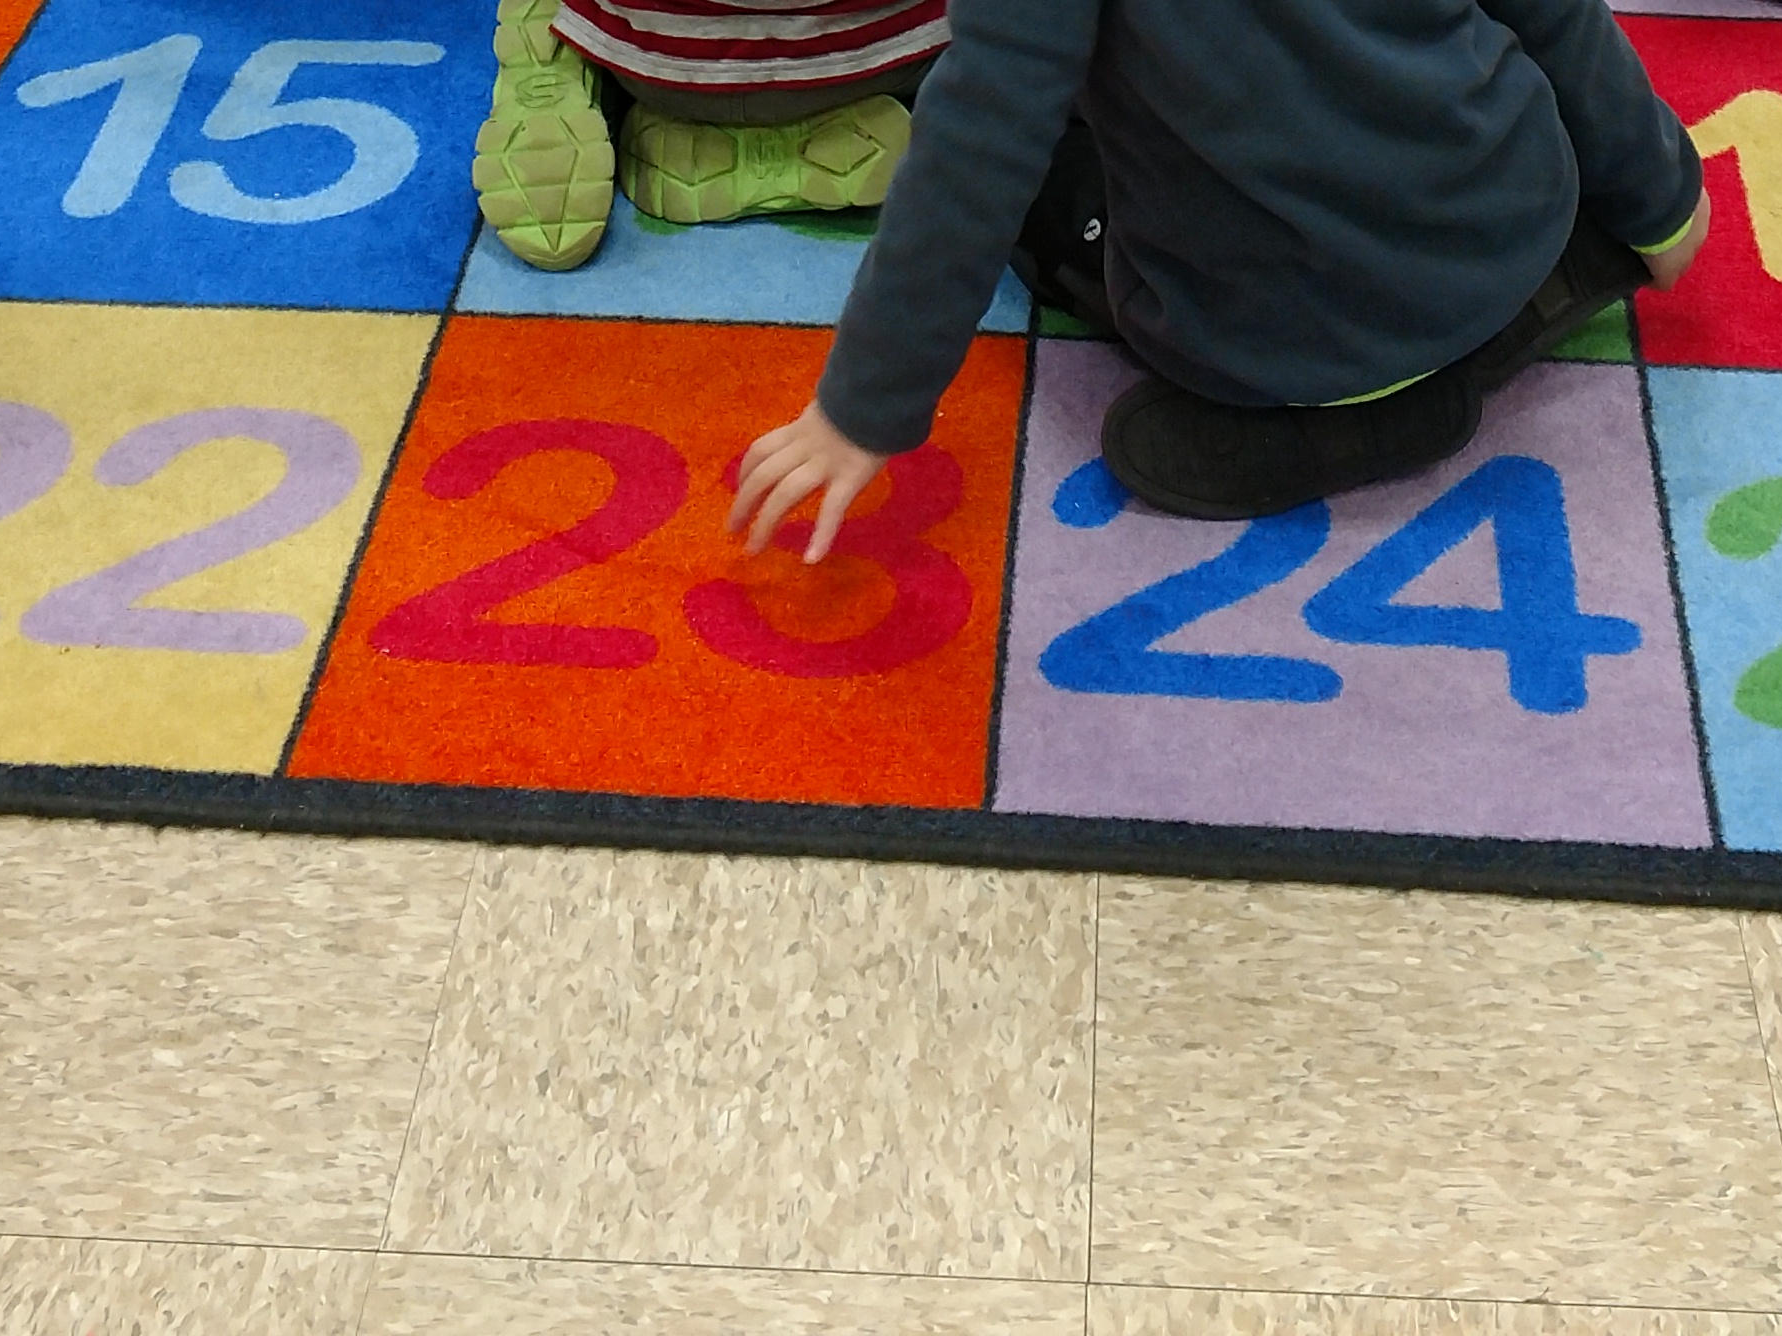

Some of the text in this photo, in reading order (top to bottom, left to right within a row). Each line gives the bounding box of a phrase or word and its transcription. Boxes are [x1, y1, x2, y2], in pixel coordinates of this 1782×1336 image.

[16, 32, 446, 225] 15
[366, 416, 974, 679] 23
[1036, 453, 1644, 716] 24
